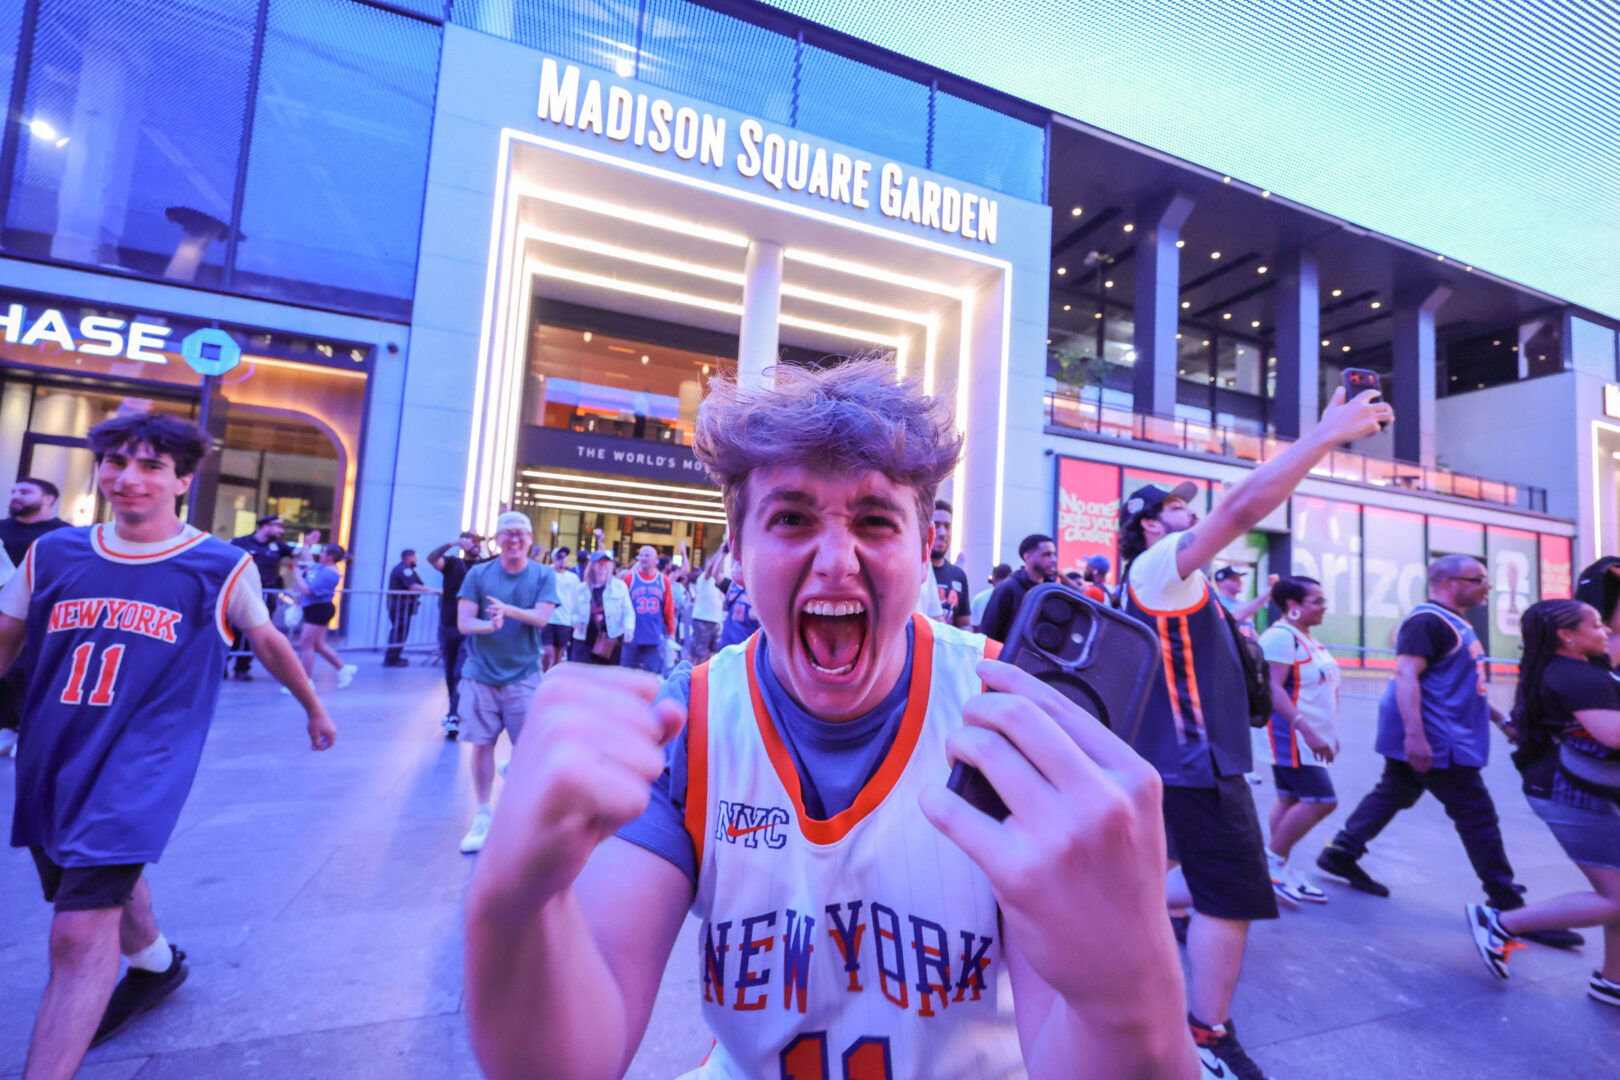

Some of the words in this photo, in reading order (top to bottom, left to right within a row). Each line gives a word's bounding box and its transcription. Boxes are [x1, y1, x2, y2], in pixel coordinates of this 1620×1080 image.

[538, 58, 726, 168] MADISON
[735, 119, 872, 209] SQUARE
[880, 162, 998, 244] GARDEN
[577, 446, 606, 459] THE
[614, 451, 676, 469] WORLD'S
[683, 460, 706, 471] MO
[1059, 488, 1086, 513] No
[1087, 499, 1120, 517] one
[47, 598, 105, 634] NEW
[102, 598, 183, 644] YORK
[636, 597, 660, 613] 33
[60, 641, 126, 706] 11
[715, 800, 790, 849] NYC
[703, 908, 815, 1014] NEW
[825, 900, 993, 1017] YORK
